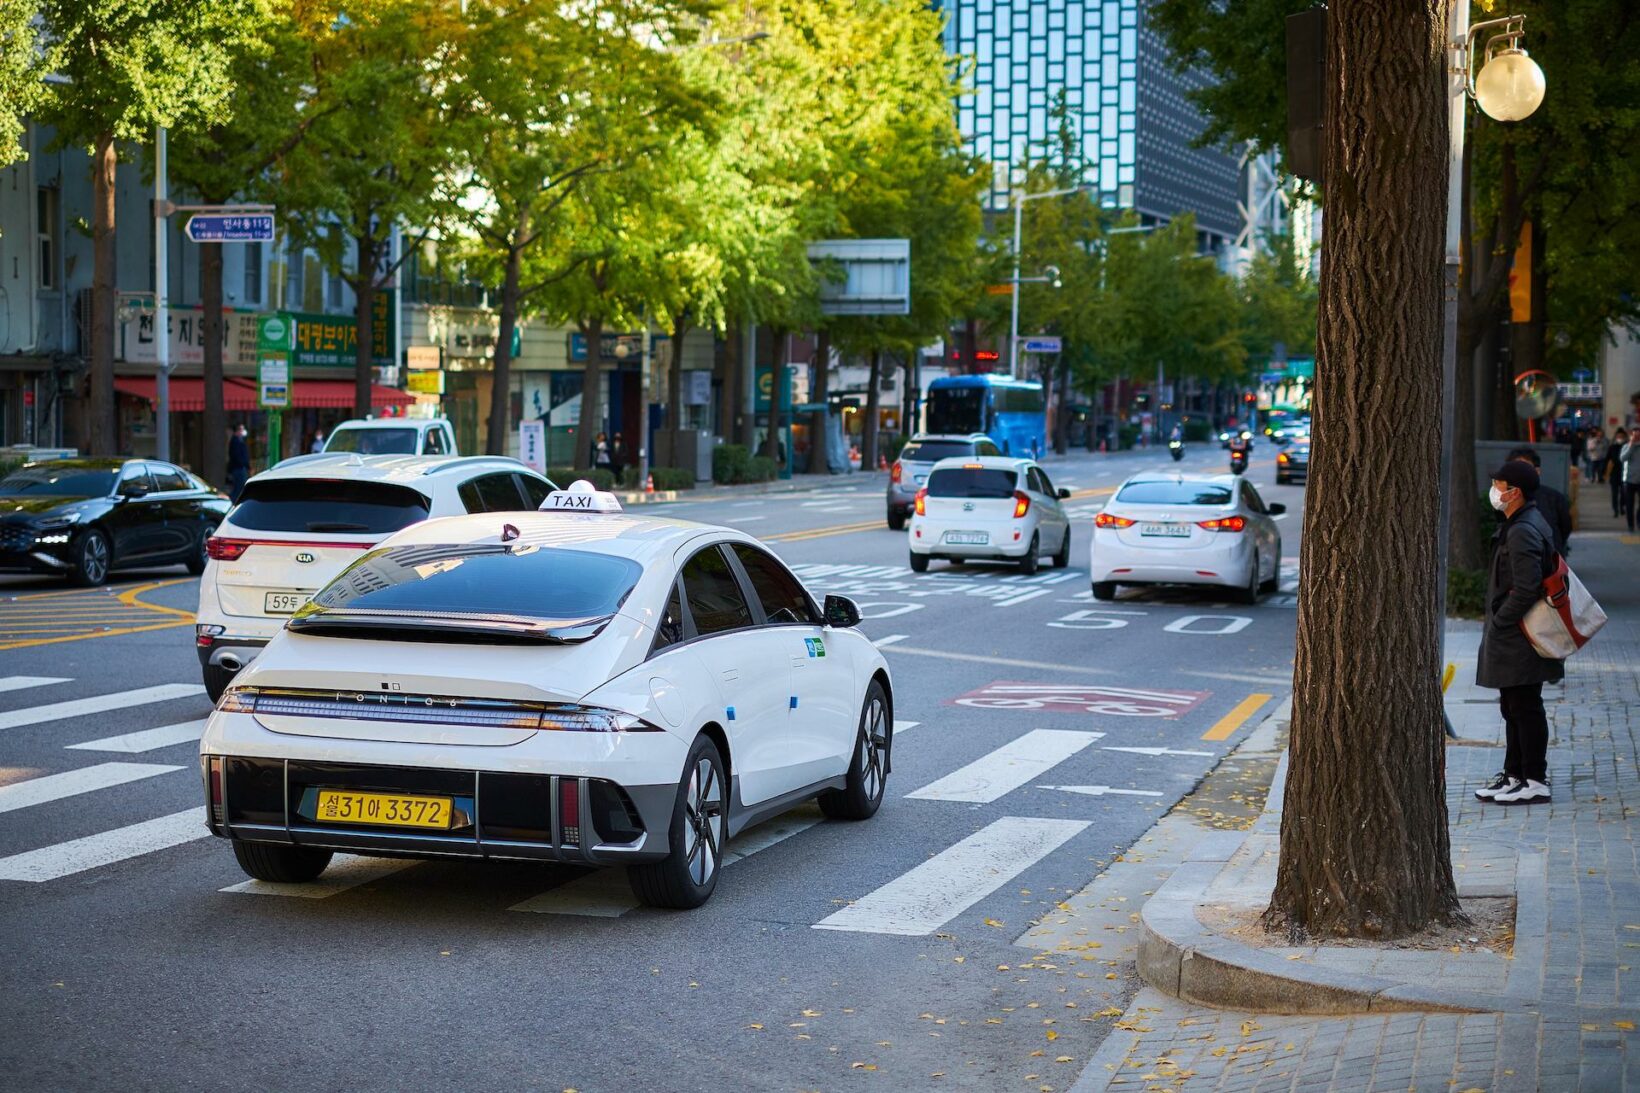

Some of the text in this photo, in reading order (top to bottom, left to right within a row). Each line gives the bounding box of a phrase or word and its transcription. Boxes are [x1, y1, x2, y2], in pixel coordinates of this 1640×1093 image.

[553, 495, 592, 508] TAXI
[297, 554, 312, 562] KIA
[273, 595, 298, 609] 59두
[1046, 609, 1254, 635] 50
[336, 692, 433, 706] IONIQ
[385, 799, 441, 824] 3372
